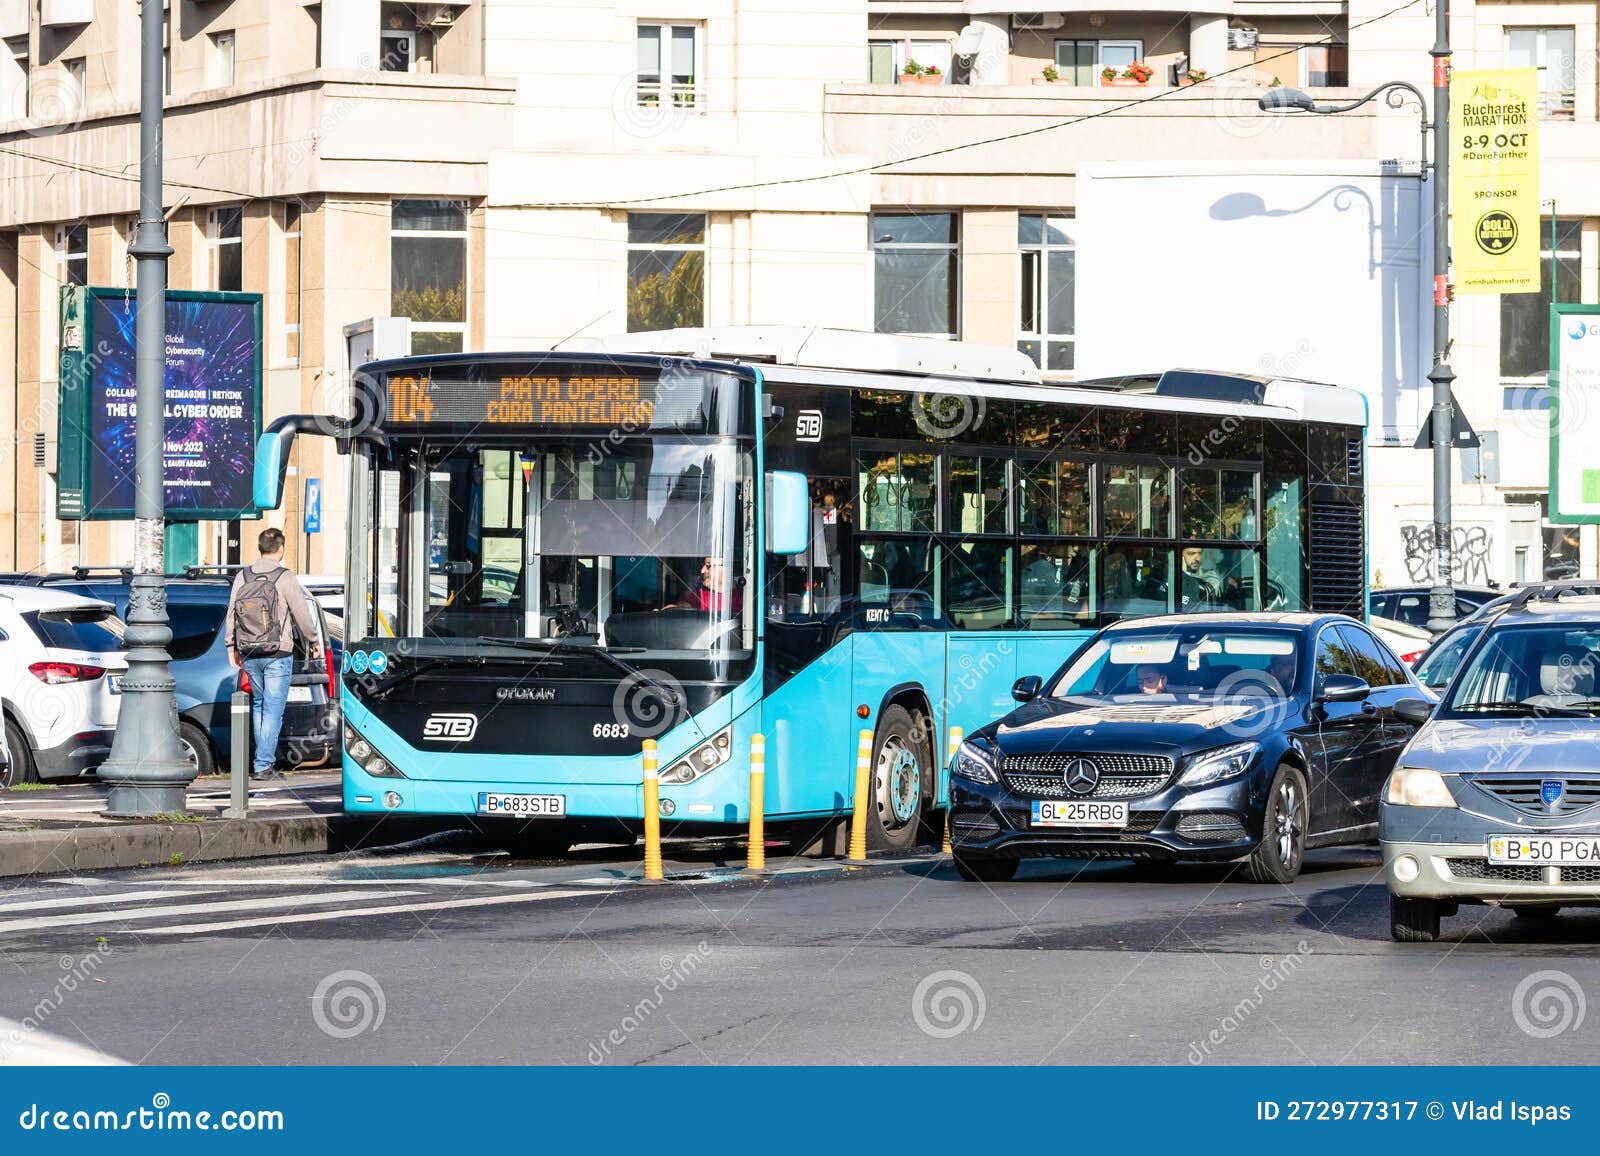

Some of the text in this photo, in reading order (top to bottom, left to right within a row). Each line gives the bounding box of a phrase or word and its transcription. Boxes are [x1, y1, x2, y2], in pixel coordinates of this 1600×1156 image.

[1463, 102, 1526, 116] Bucharest
[1463, 114, 1527, 127] MARATHON
[1463, 133, 1528, 149] 8-9 OCT
[1463, 150, 1528, 160] #DareFurther
[1474, 189, 1518, 199] SPONSOR
[165, 334, 185, 344] Global
[165, 347, 205, 357] Cybersecurity
[165, 358, 185, 366] Forum
[166, 390, 206, 399] REIMAGINE
[212, 391, 243, 400] RETHINK
[389, 377, 640, 422] 104 PIATA OPEREI
[106, 403, 127, 417] THE
[173, 405, 208, 418] CYBER
[209, 405, 243, 419] ORDER
[487, 400, 534, 423] CORA
[796, 414, 821, 438] STB
[167, 442, 183, 451] Nov
[184, 441, 203, 452] 2022
[866, 609, 884, 622] KENT
[496, 687, 556, 700] OTOKAR
[423, 716, 629, 739] STB 6683
